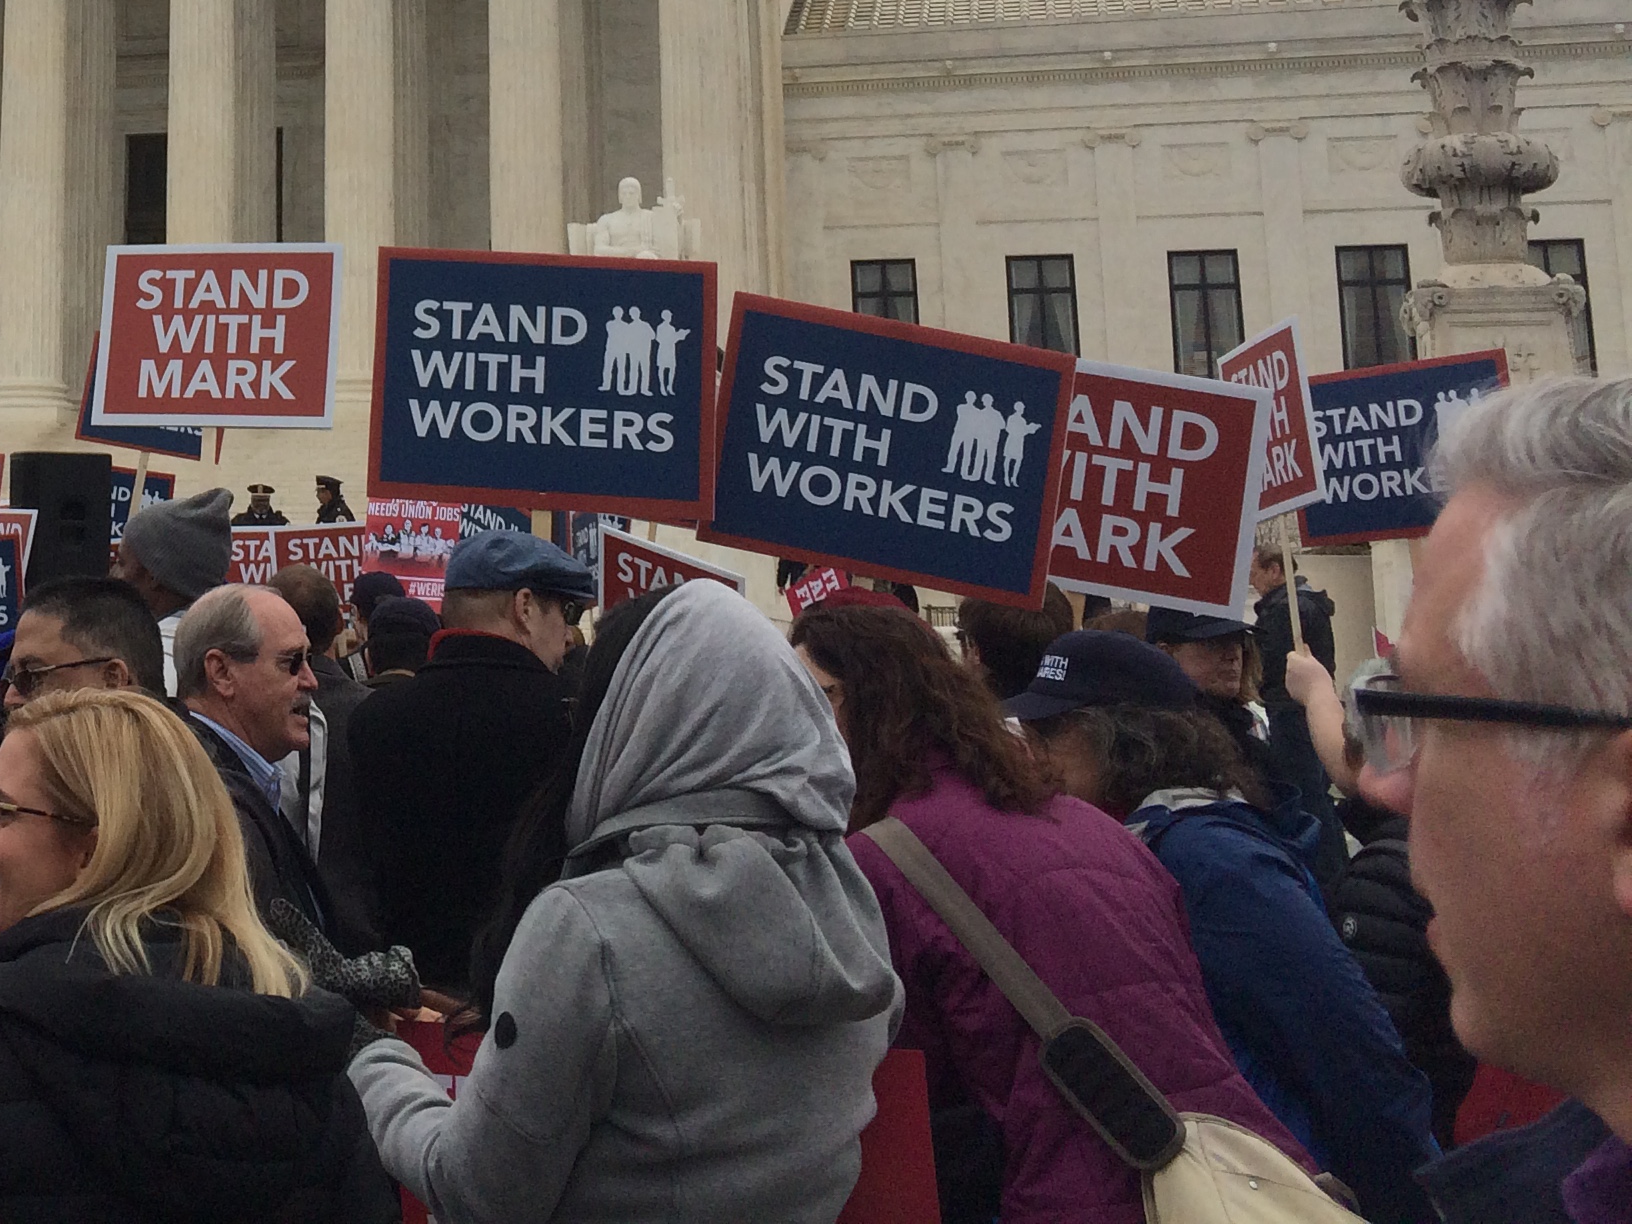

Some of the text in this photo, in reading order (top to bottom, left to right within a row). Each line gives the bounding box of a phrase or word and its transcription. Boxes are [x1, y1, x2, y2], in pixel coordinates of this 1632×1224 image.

[135, 269, 310, 310] STAND
[152, 314, 286, 354] WITH
[413, 299, 588, 346] STAND
[137, 359, 297, 400] MARK
[411, 349, 546, 394] WITH
[759, 355, 939, 422] STAND
[408, 398, 674, 453] WORKERS
[755, 403, 891, 467] WITH
[1313, 398, 1423, 438] STAND
[1322, 435, 1403, 470] WITH
[747, 452, 1015, 543] WORKERS
[1062, 448, 1185, 517] ITH
[368, 502, 399, 517] NEEDS
[401, 503, 433, 519] UNION
[434, 506, 461, 522] JOBS
[288, 535, 365, 561] STAN
